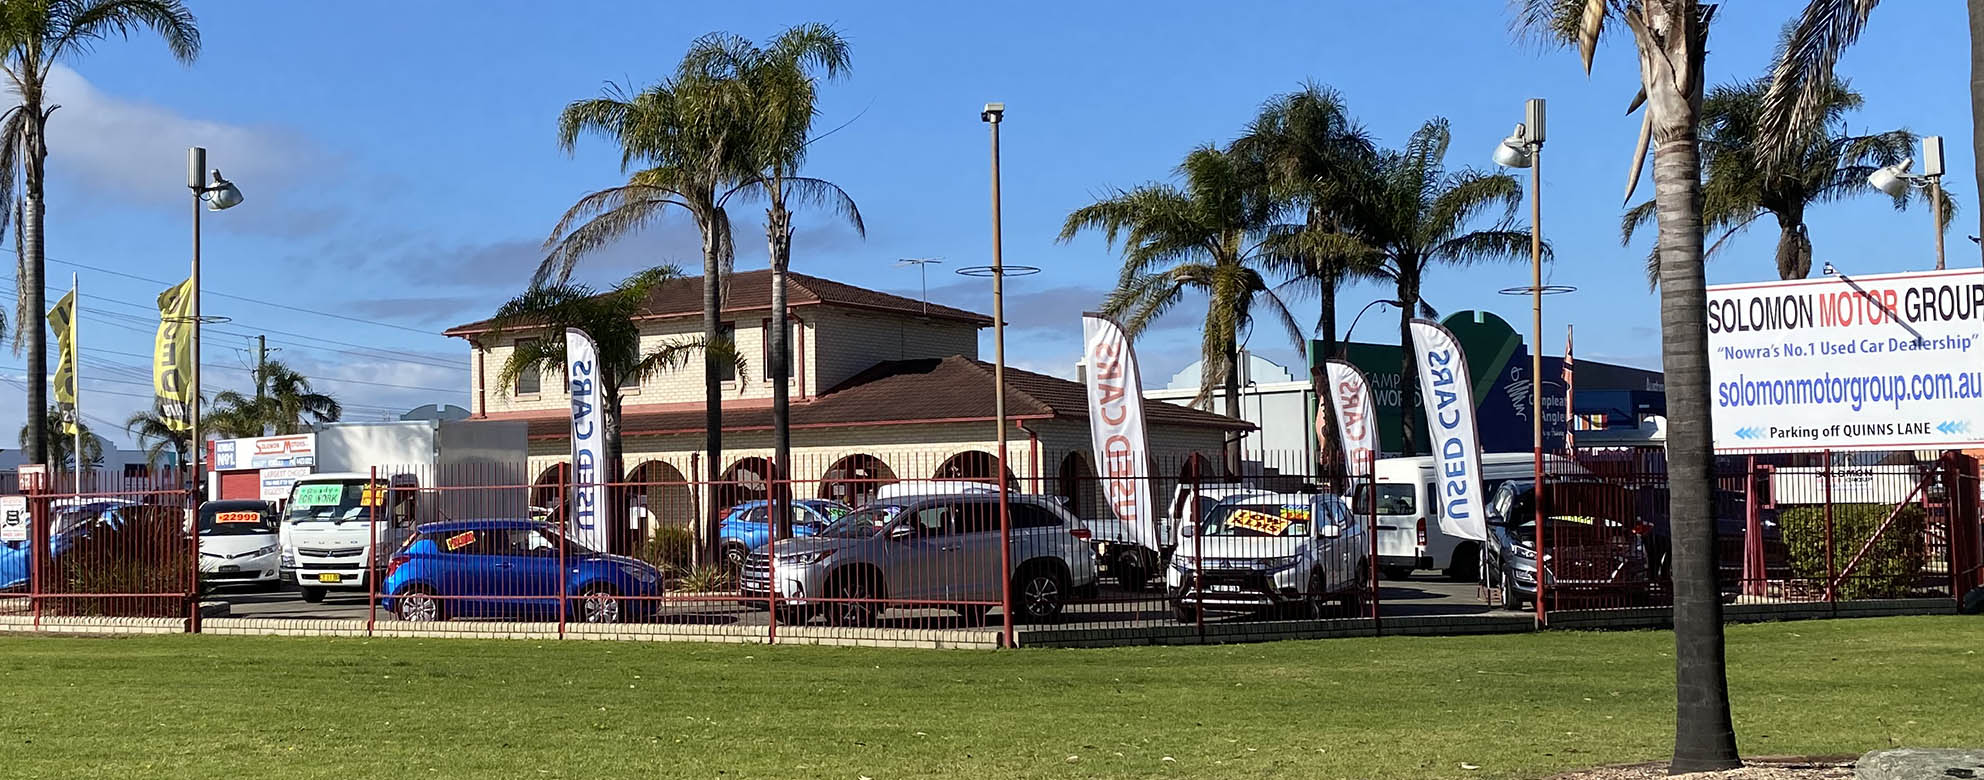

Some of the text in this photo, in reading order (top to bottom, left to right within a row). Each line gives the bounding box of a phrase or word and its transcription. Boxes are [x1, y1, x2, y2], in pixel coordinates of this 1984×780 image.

[1708, 284, 1984, 334] SOLOMON MOTOR GROUP
[1784, 342, 1815, 356] No.1
[1821, 338, 1856, 355] Used
[1860, 339, 1884, 353] Car
[1719, 372, 1982, 411] solomonmotorgroup.com.au
[1769, 422, 1931, 440] Parking off QUINNS LANE
